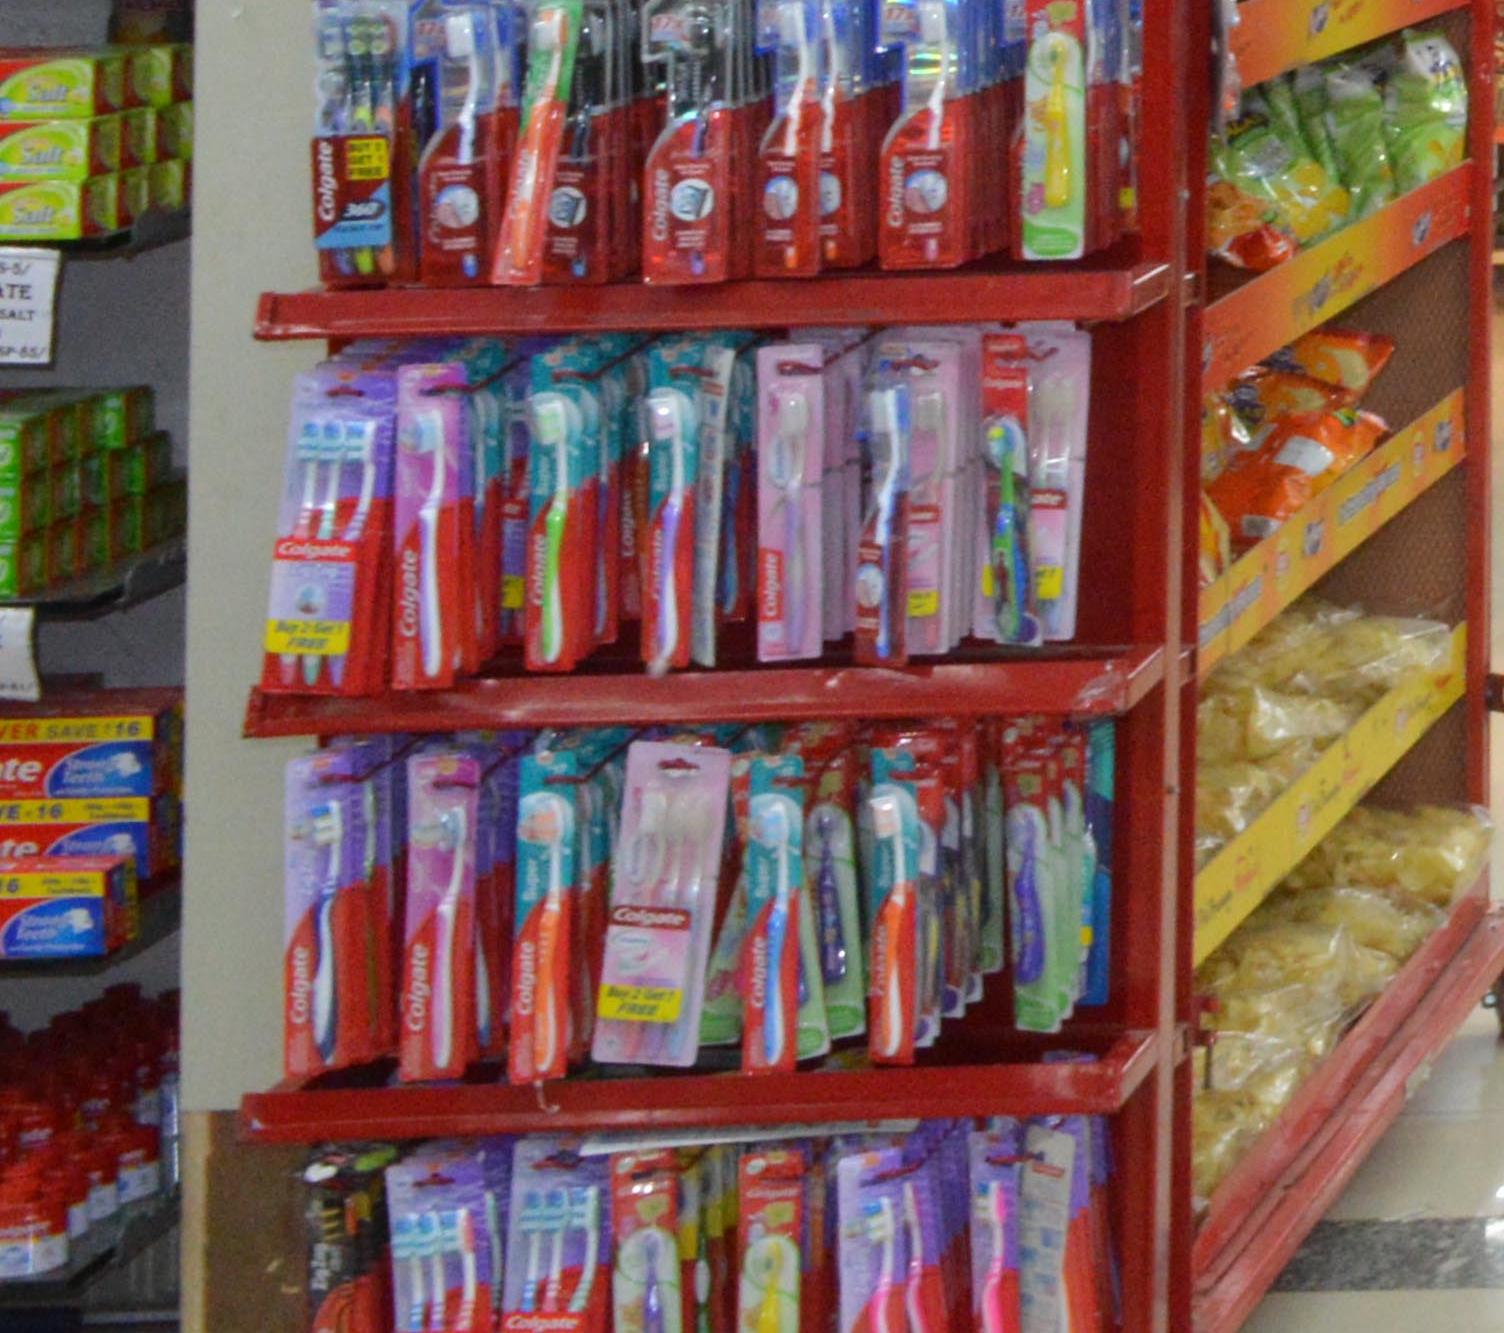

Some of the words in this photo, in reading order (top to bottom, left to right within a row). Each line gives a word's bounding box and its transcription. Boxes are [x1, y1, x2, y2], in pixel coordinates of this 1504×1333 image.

[26, 84, 68, 103] Salt
[12, 205, 54, 224] Salt
[317, 141, 335, 222] Colgate
[650, 166, 670, 244] Colgate
[276, 539, 355, 561] Colgate
[399, 547, 420, 641] Colgate
[763, 556, 781, 624] Colgate
[49, 726, 95, 739] SAVE
[610, 906, 692, 928] Colgate
[288, 944, 311, 1025] Colgate
[404, 941, 429, 1035] Colgate
[515, 941, 536, 1017] Colgate
[504, 1313, 581, 1333] Colgate
